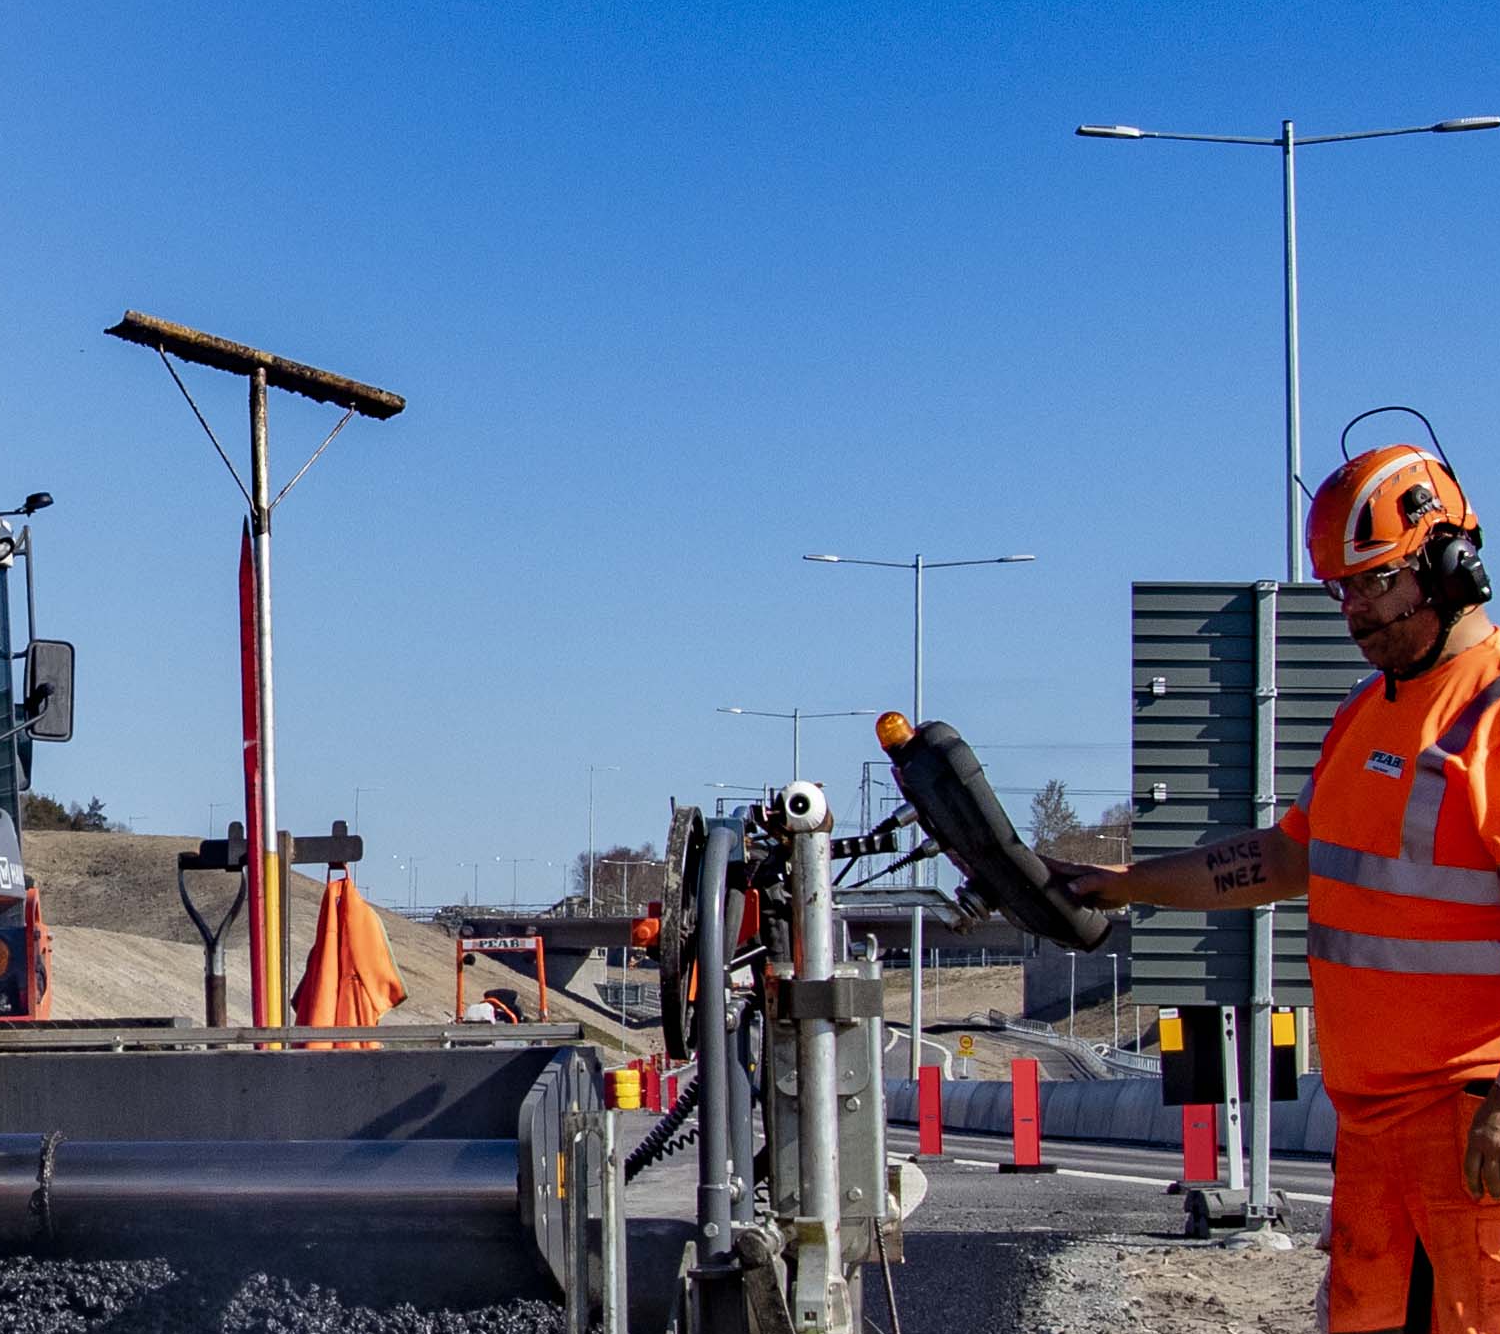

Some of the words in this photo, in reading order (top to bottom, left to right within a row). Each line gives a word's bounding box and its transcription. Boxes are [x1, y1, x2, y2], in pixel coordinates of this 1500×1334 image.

[1207, 841, 1261, 870] ALICE
[1214, 863, 1266, 894] INEZ
[480, 939, 520, 948] PEAB
